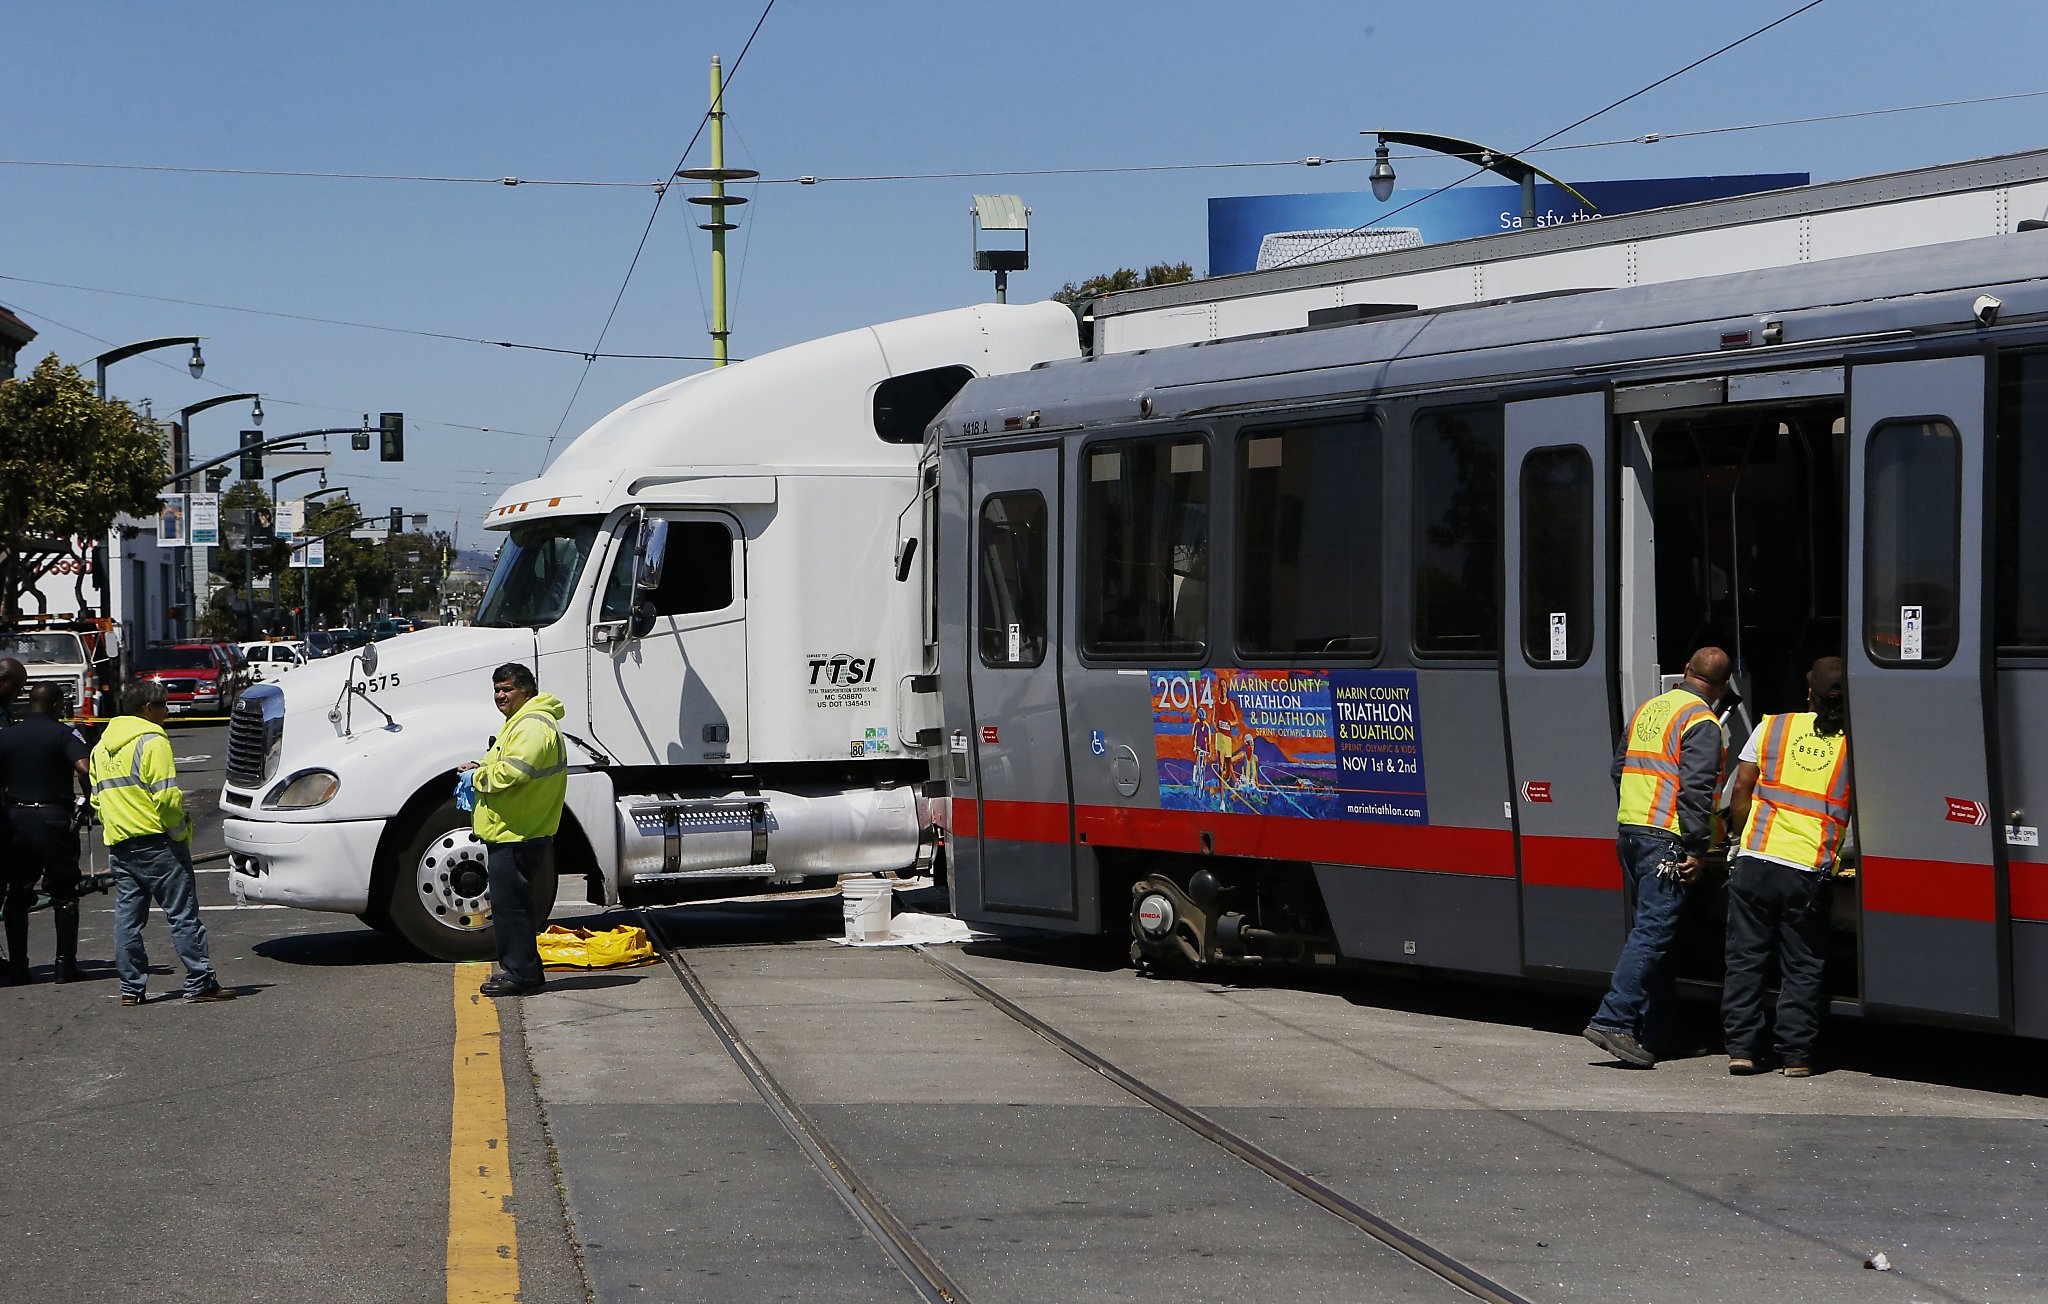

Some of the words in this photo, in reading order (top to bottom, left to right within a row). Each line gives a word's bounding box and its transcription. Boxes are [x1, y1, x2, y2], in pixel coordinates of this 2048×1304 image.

[1500, 209, 1564, 229] Sasfy
[962, 421, 980, 436] 1418
[982, 419, 989, 434] A
[808, 657, 876, 685] TTSI
[357, 672, 401, 695] 9575
[1229, 678, 1268, 693] MARIN
[1270, 678, 1321, 694] COUNTY
[1156, 676, 1214, 709] 2014
[1336, 687, 1368, 700] MARIN
[1369, 687, 1410, 701] COUNTY
[1237, 694, 1301, 709] TRIATHLON
[1250, 711, 1259, 725] &
[1261, 711, 1326, 727] DUATHLON
[1336, 702, 1413, 723] TRIATHLON
[1255, 728, 1278, 738] SPRINT,
[1278, 728, 1306, 738] OLYMPIC
[1306, 729, 1312, 738] &
[1312, 729, 1327, 738] KIDS
[1339, 723, 1349, 739] &
[1351, 724, 1415, 741] DUATHLON
[852, 746, 863, 756] 80
[1341, 742, 1364, 753] SPRINT,
[1365, 743, 1393, 753] OLYMPIC
[1394, 745, 1400, 753] &
[1401, 745, 1417, 754] KIDS
[1342, 756, 1368, 772] NOV
[1371, 757, 1384, 773] 1st
[1386, 758, 1396, 773] &
[1397, 758, 1417, 774] 2nd
[1347, 803, 1421, 818] marintriathlon.com
